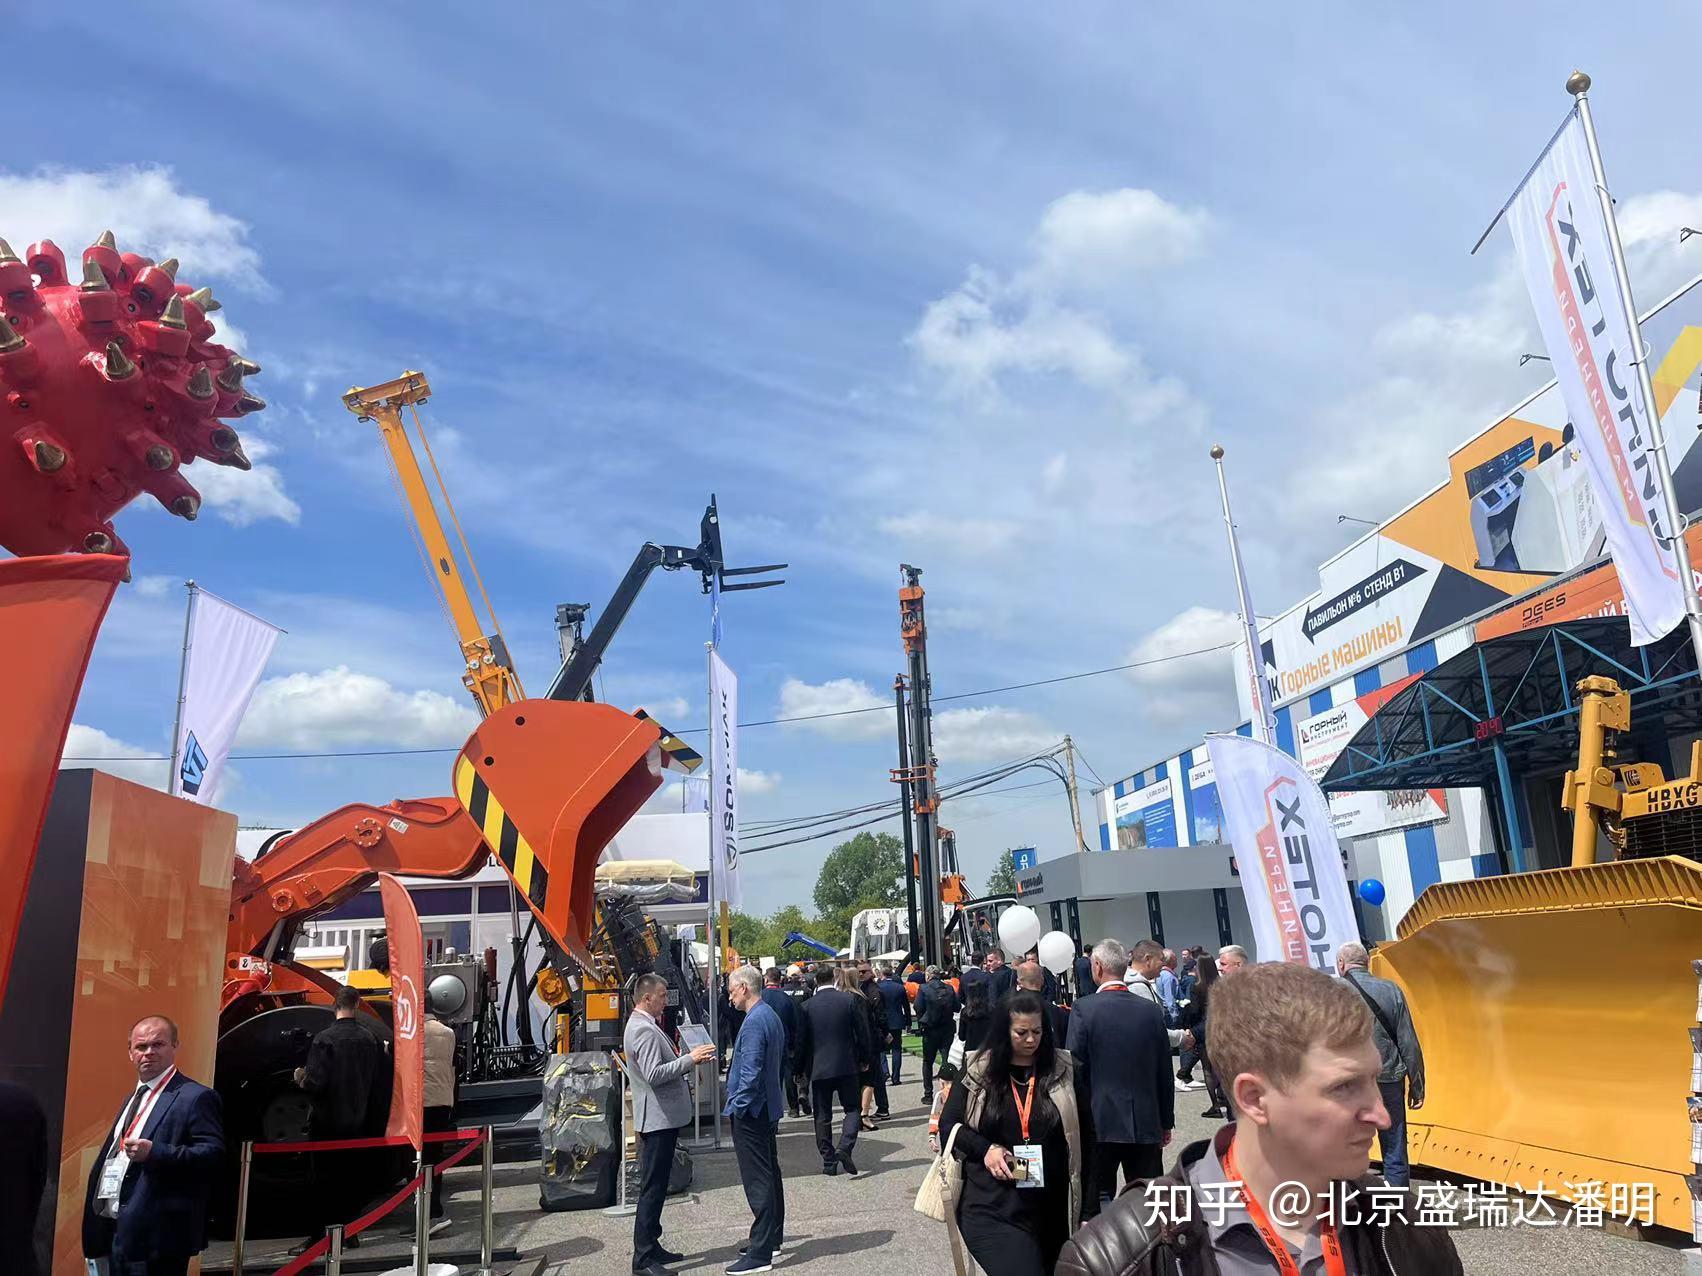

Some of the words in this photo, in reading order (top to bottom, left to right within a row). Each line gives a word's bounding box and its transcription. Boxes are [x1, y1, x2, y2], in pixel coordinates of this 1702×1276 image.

[1307, 599, 1348, 632] ПАВИЛЬОН
[1347, 591, 1362, 609] №6
[1364, 572, 1394, 599] СТЕНД
[1393, 564, 1405, 582] В1
[1522, 592, 1567, 622] DEES
[1308, 710, 1348, 735] ГОРНЫЙ
[1310, 723, 1349, 742] ИНСТРУМЕНТ
[1647, 783, 1699, 813] HBXG
